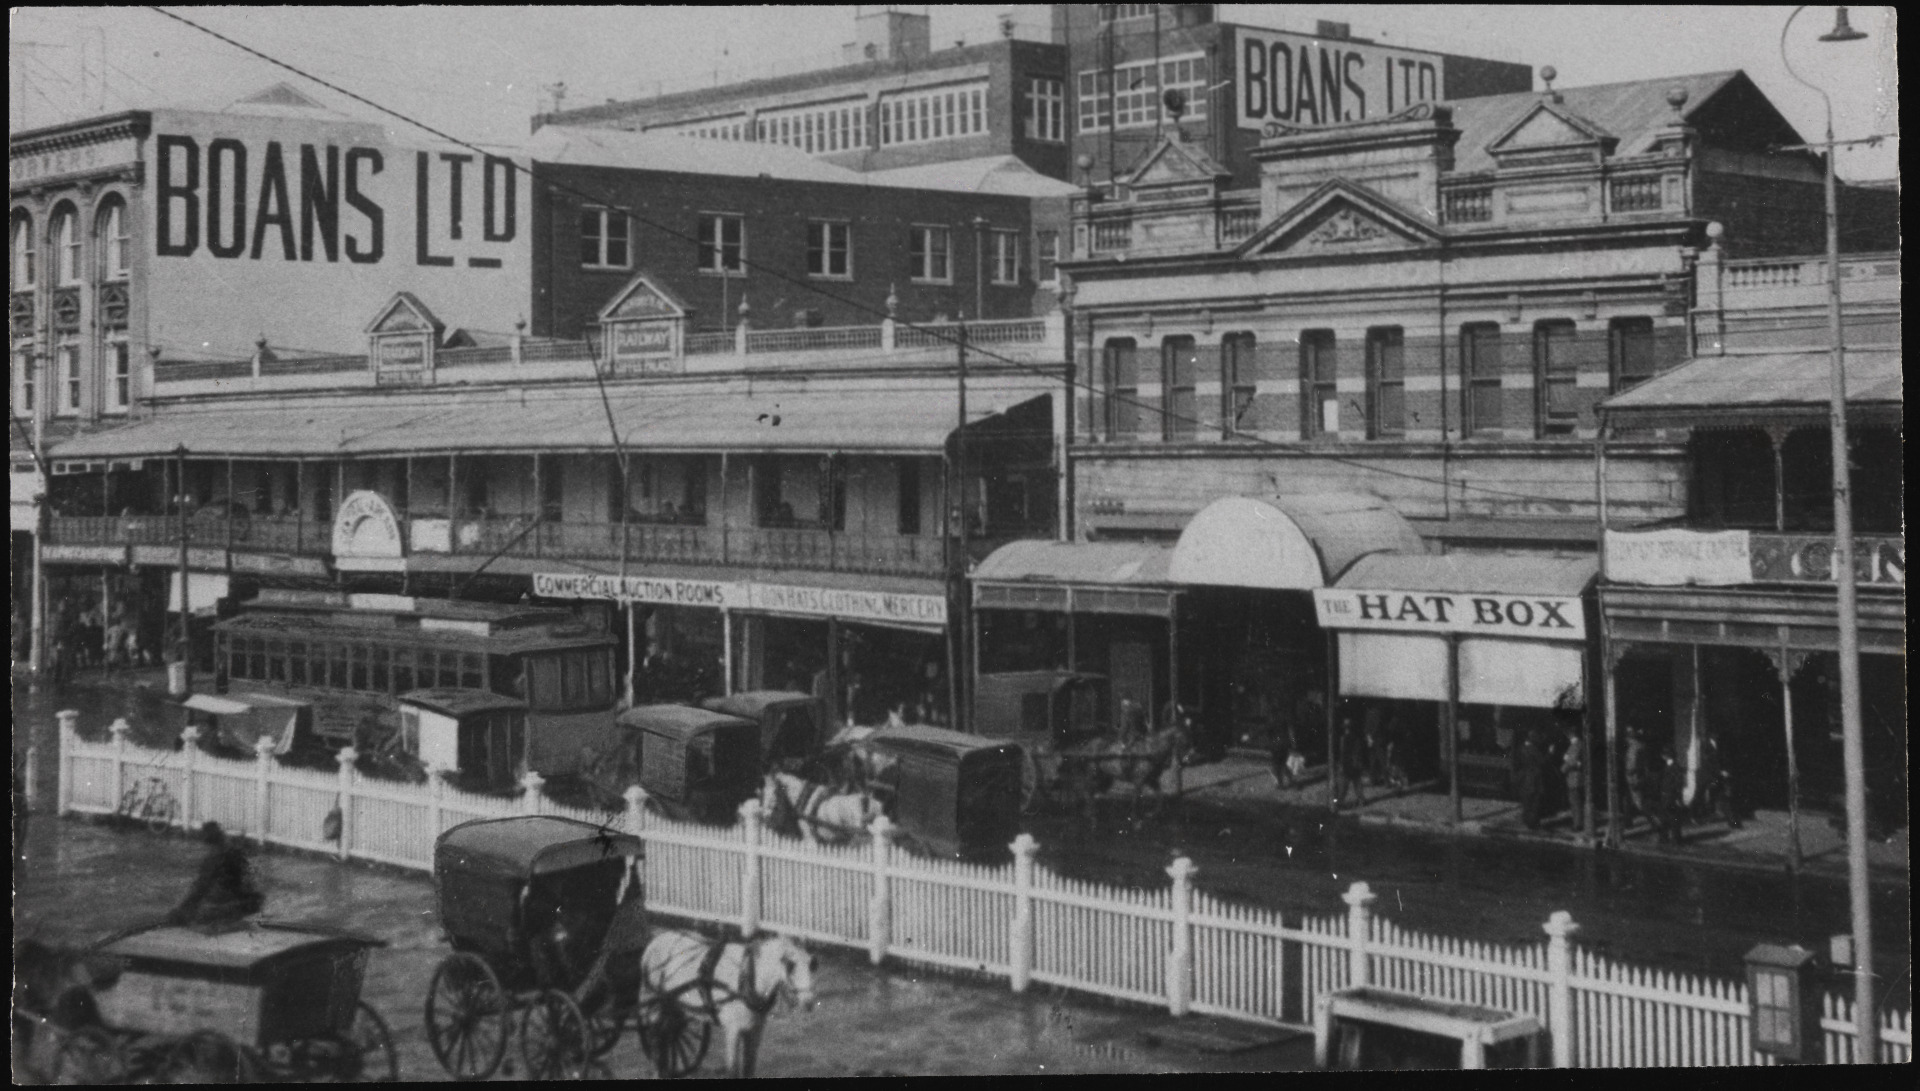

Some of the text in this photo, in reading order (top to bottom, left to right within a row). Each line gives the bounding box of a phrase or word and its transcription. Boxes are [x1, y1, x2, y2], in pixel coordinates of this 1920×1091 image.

[1244, 37, 1365, 125] BOANS
[156, 133, 516, 268] BOANS LTD
[535, 575, 619, 597] COMMERCIAL
[676, 581, 725, 604] ROOMS
[1322, 593, 1576, 629] THE HAT BOX
